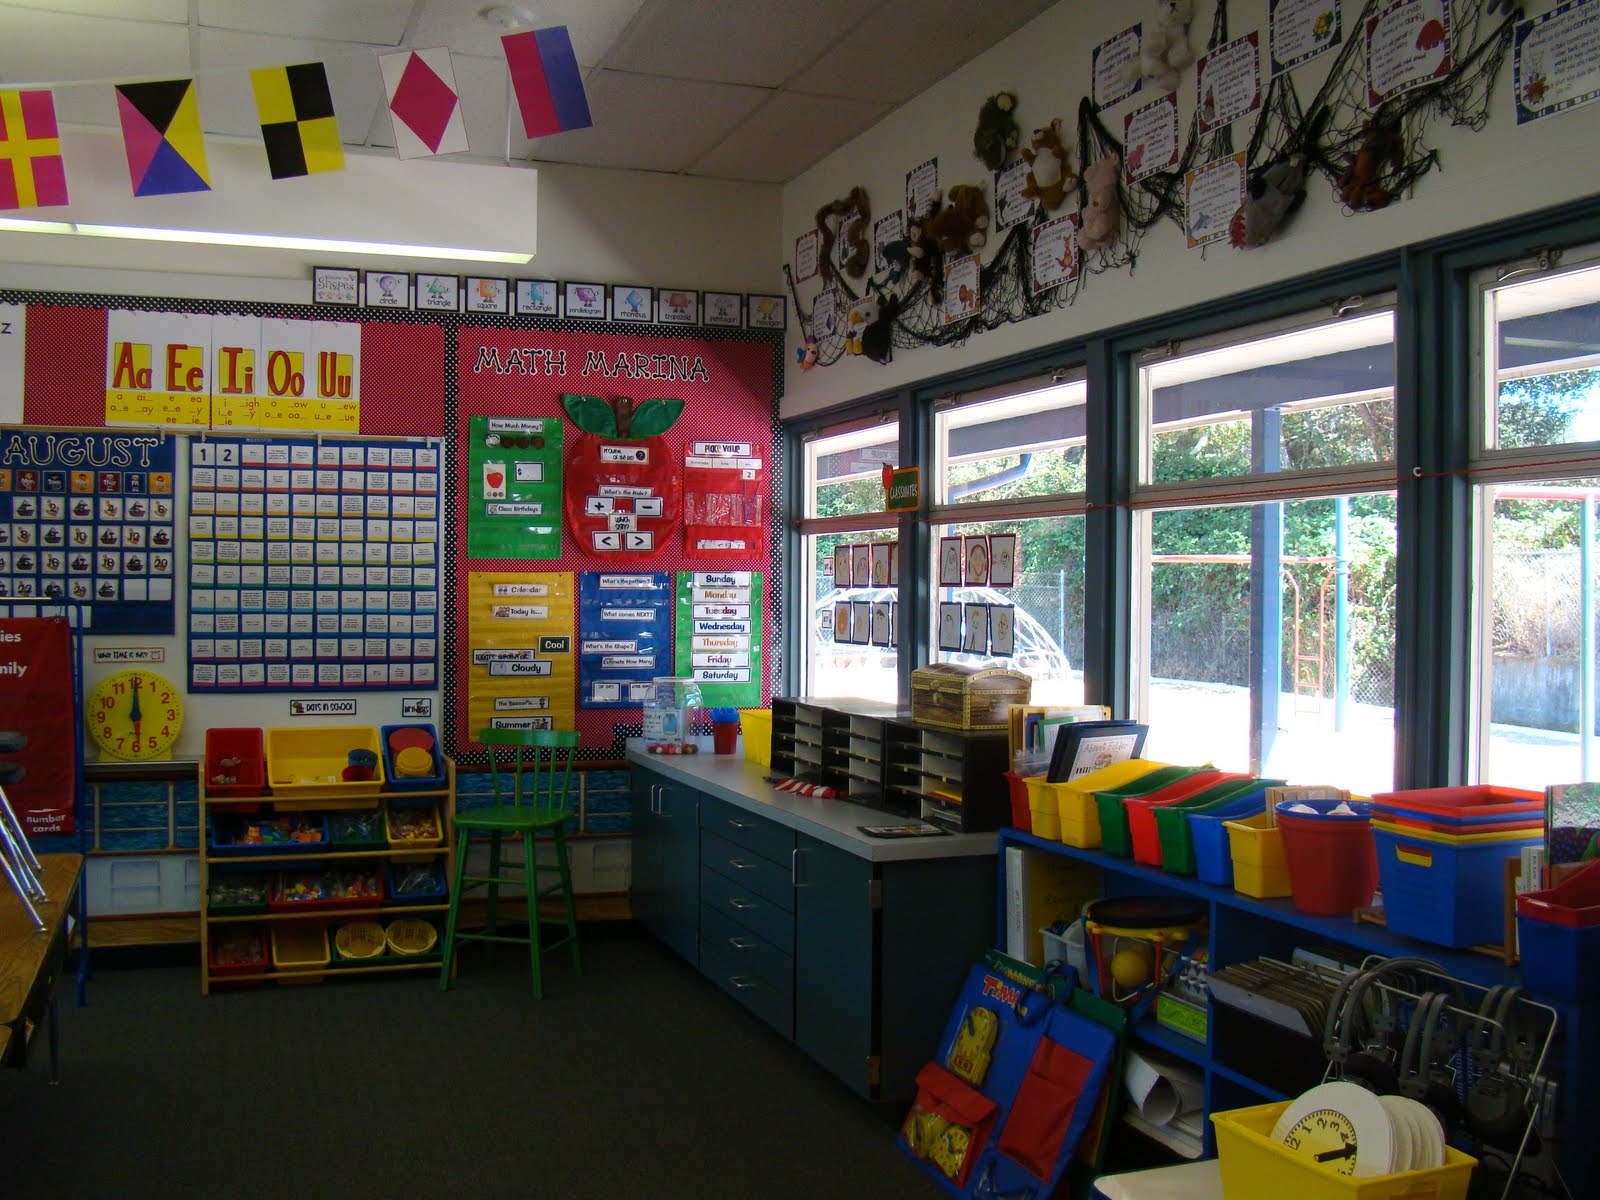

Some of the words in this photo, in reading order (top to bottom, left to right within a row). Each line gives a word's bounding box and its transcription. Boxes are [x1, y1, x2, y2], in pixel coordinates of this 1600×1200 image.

[427, 299, 451, 307] triangle
[476, 302, 498, 310] square
[522, 304, 552, 313] rectangle
[621, 310, 646, 319] rhombus
[112, 342, 152, 388] Aa
[166, 344, 204, 391] Ee
[474, 347, 566, 376] MATH
[582, 351, 710, 382] MARINA
[222, 347, 254, 394] Ii
[267, 350, 305, 396] Oo
[320, 352, 351, 398] Uu
[491, 421, 504, 429] How
[521, 423, 543, 431] Money?
[3, 435, 158, 467] AUGUST
[200, 448, 207, 461] 1
[223, 448, 232, 462] 2
[889, 483, 918, 499] CLASSMATES
[513, 505, 539, 513] Birthdays
[75, 532, 87, 540] 10
[154, 558, 168, 568] 20
[705, 574, 736, 585] Sunday
[704, 590, 737, 600] Monday
[510, 608, 529, 616] Today
[705, 606, 737, 616] Tuesday
[699, 622, 745, 632] Wednesday
[545, 640, 565, 649] Cool
[702, 638, 738, 648] Thursday
[707, 655, 732, 665] Friday
[511, 663, 542, 674] Cloudy
[702, 670, 738, 680] Saturday
[113, 683, 125, 694] 11
[150, 682, 156, 693] 1
[100, 697, 115, 708] 10
[161, 693, 170, 704] 2
[97, 712, 106, 723] 9
[167, 709, 176, 721] 3
[495, 721, 531, 729] Summer
[103, 727, 112, 739] 8
[161, 726, 170, 737] 4
[116, 738, 125, 750] 7
[132, 741, 141, 752] 6
[148, 737, 157, 748] 5
[26, 814, 66, 824] number
[32, 824, 61, 833] cards
[1316, 1117, 1328, 1130] 2
[1330, 1121, 1340, 1132] 3
[1302, 1125, 1312, 1134] 1
[1340, 1131, 1350, 1142] 4
